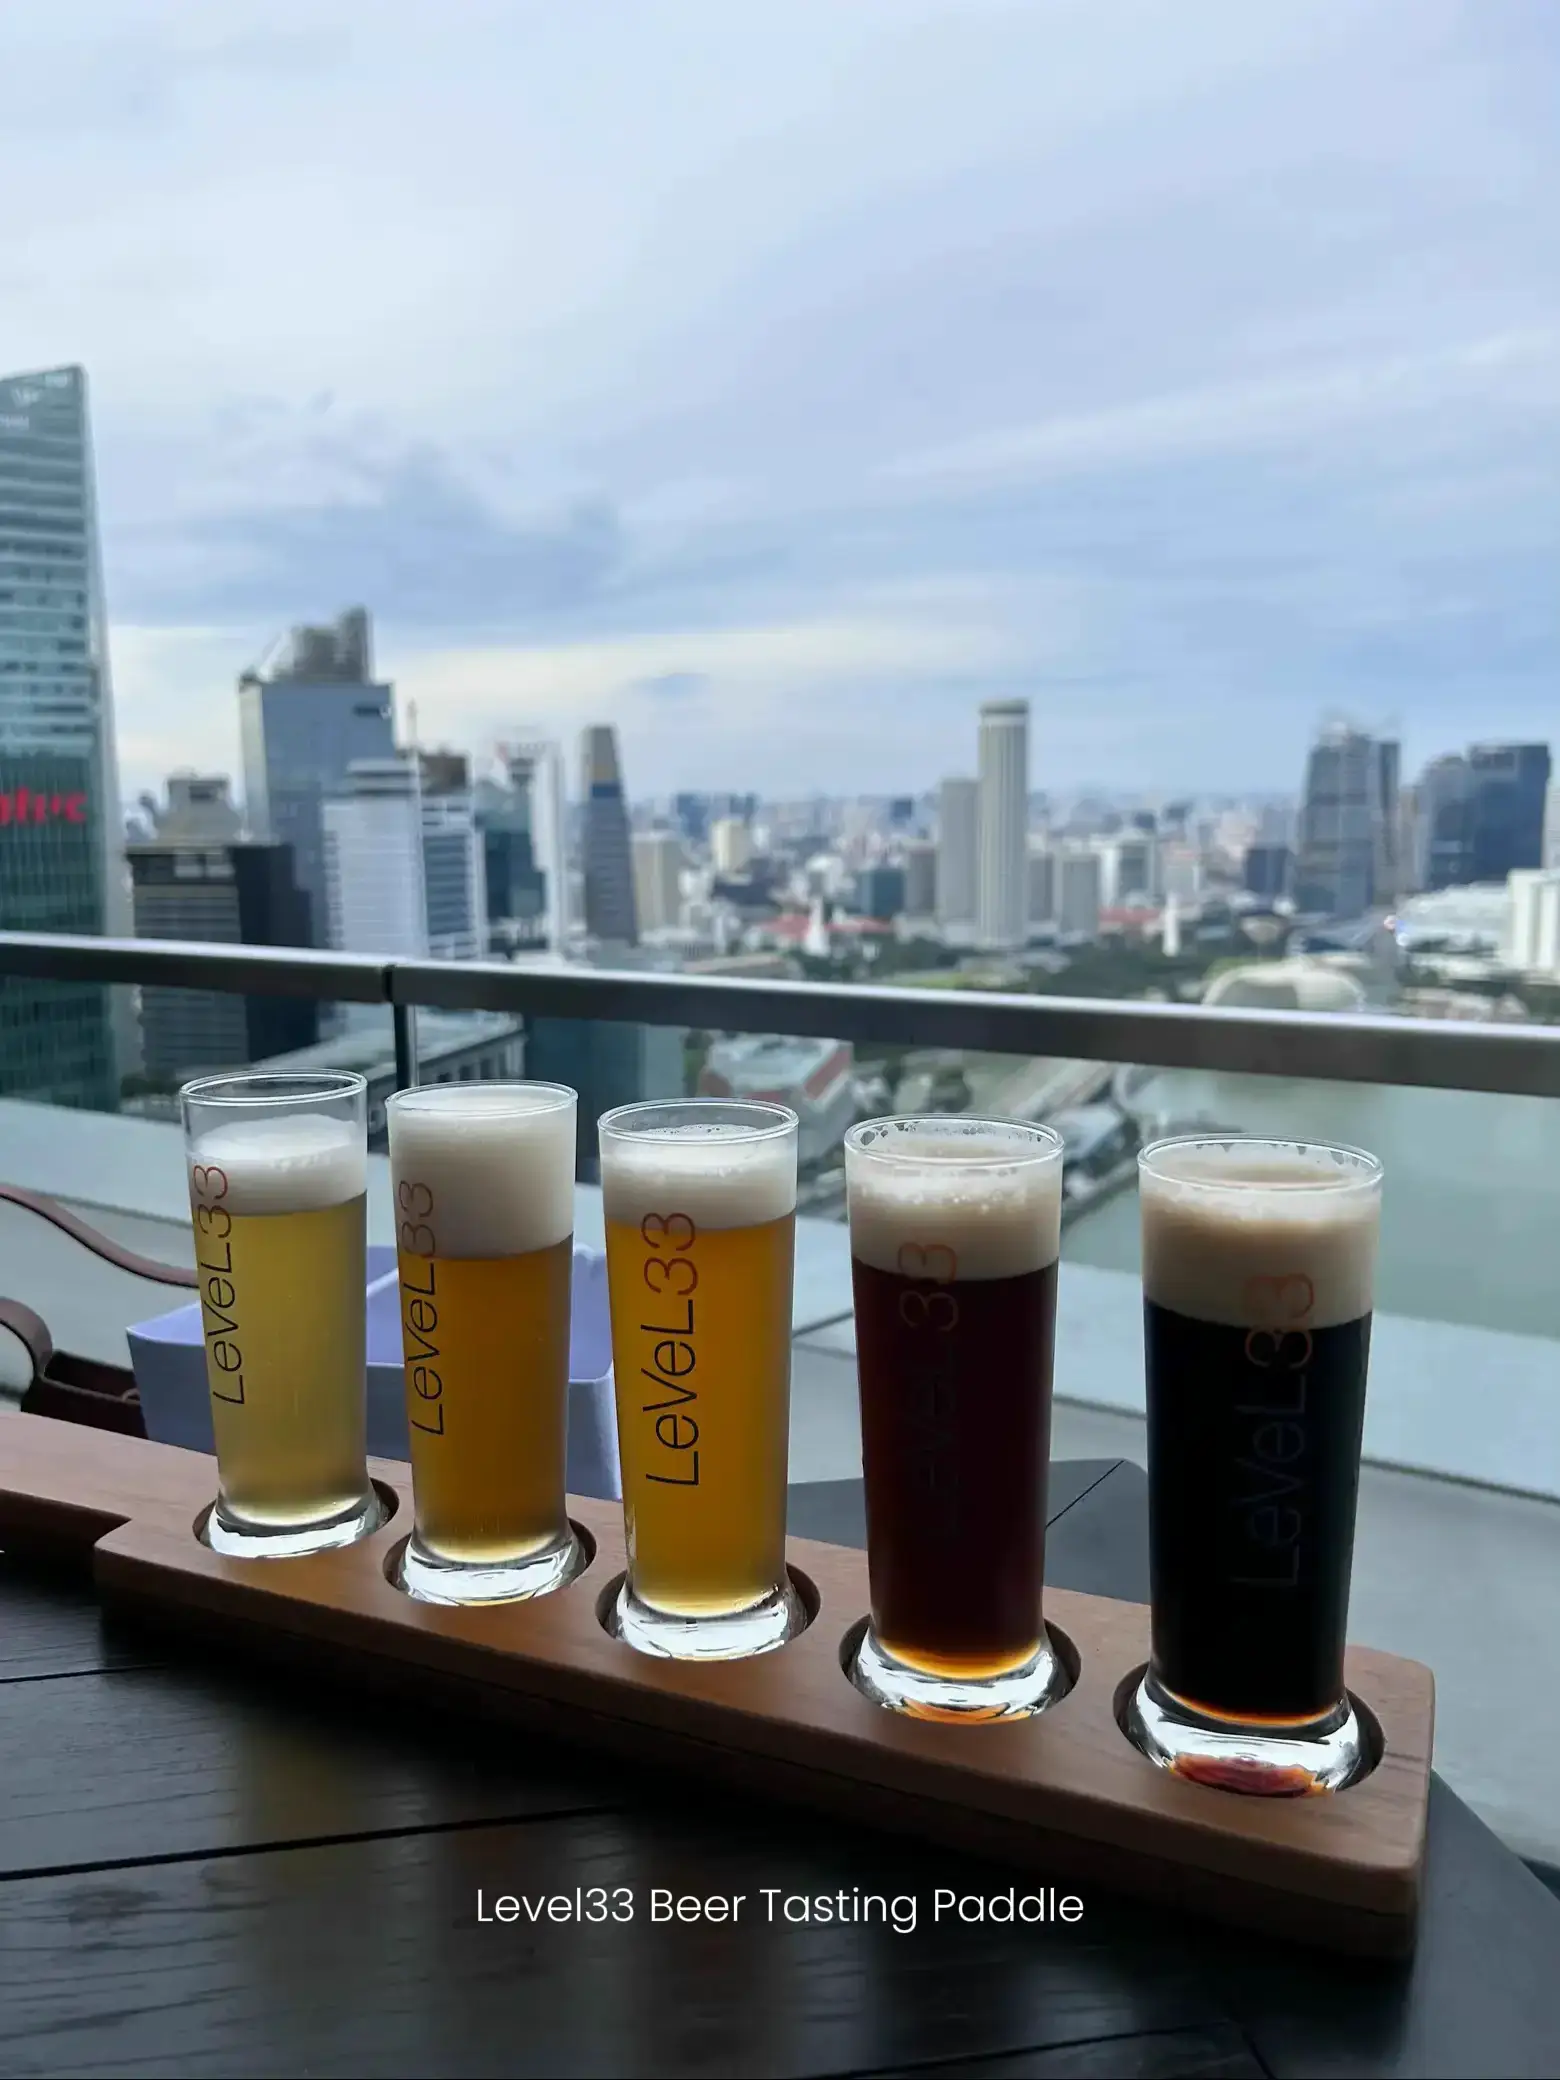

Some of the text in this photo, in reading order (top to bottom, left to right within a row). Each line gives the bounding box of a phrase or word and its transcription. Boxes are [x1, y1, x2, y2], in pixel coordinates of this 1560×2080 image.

[192, 1163, 245, 1405] LeVeL33
[398, 1180, 445, 1436] LeVeL33
[640, 1211, 700, 1487] LeVeL33
